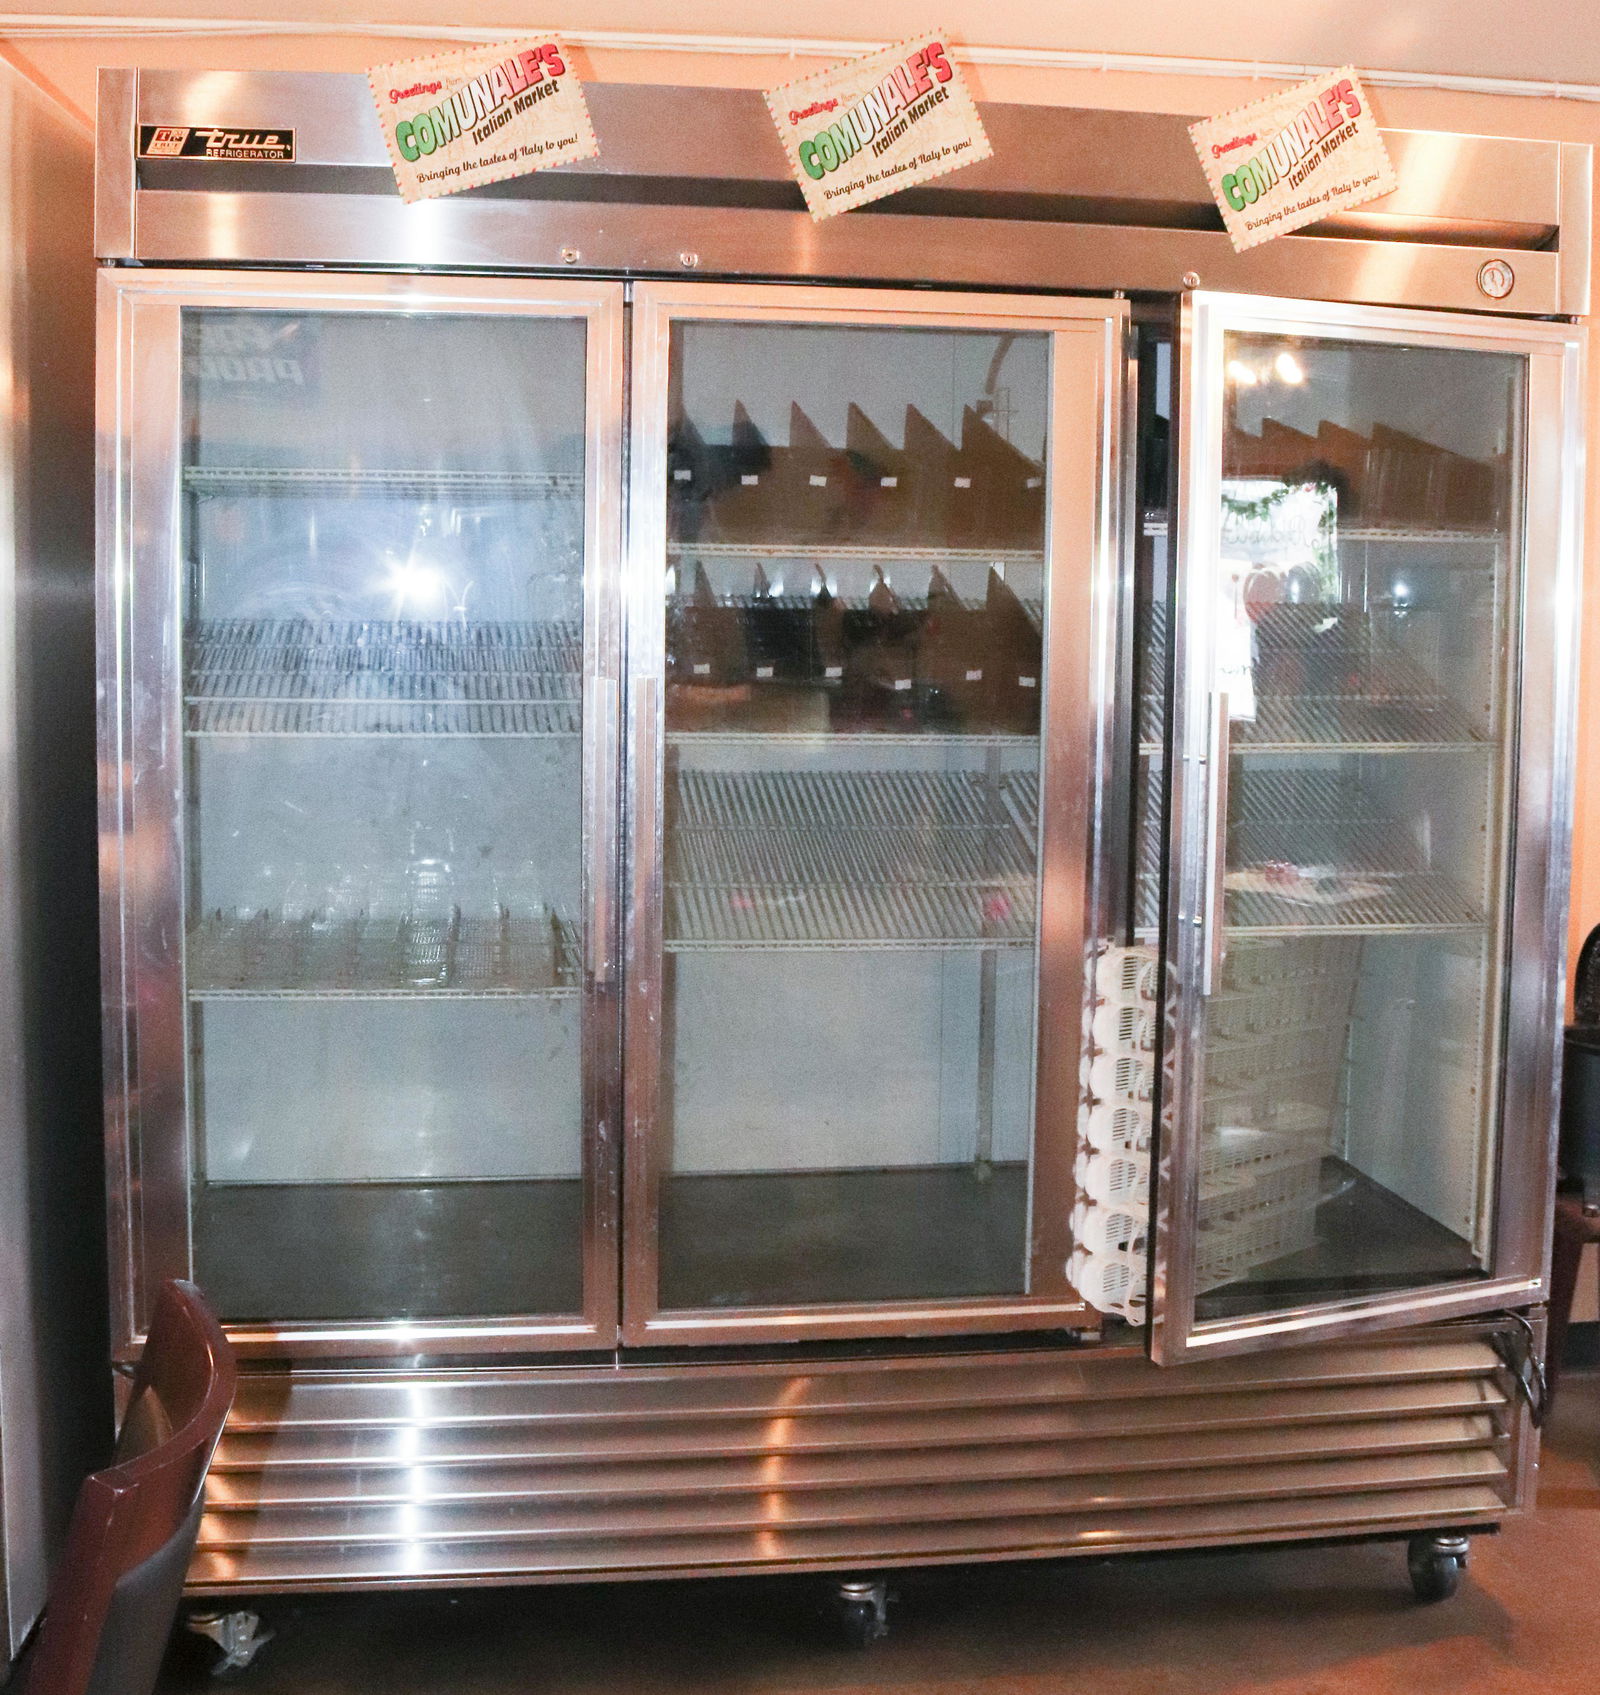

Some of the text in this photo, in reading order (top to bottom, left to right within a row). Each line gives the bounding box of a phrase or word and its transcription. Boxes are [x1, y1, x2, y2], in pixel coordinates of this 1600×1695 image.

[389, 80, 442, 104] Greetings
[396, 44, 565, 161] COMUNALE'S
[472, 79, 559, 145] Italian Market
[799, 42, 953, 180] COMUNALE'S
[871, 86, 949, 157] Italian Market
[206, 148, 284, 159] REFRIGERATOR
[417, 164, 460, 183] Bringing
[462, 160, 477, 172] the
[480, 153, 507, 168] tastes
[509, 148, 519, 161] of
[545, 140, 554, 150] to
[557, 133, 578, 149] you!
[823, 181, 866, 200] Bringing
[866, 174, 881, 185] the
[881, 164, 908, 179] tastes
[908, 157, 918, 170] of
[942, 146, 950, 156] to
[952, 138, 972, 154] you!
[1222, 79, 1361, 211] COMUNALE'S
[1288, 120, 1359, 190] Italian Market
[1245, 212, 1282, 230] Bringing
[1284, 204, 1296, 216] the
[1297, 197, 1321, 211] tastes
[1322, 191, 1330, 202] of
[1352, 179, 1361, 188] to
[1363, 171, 1381, 186] you!
